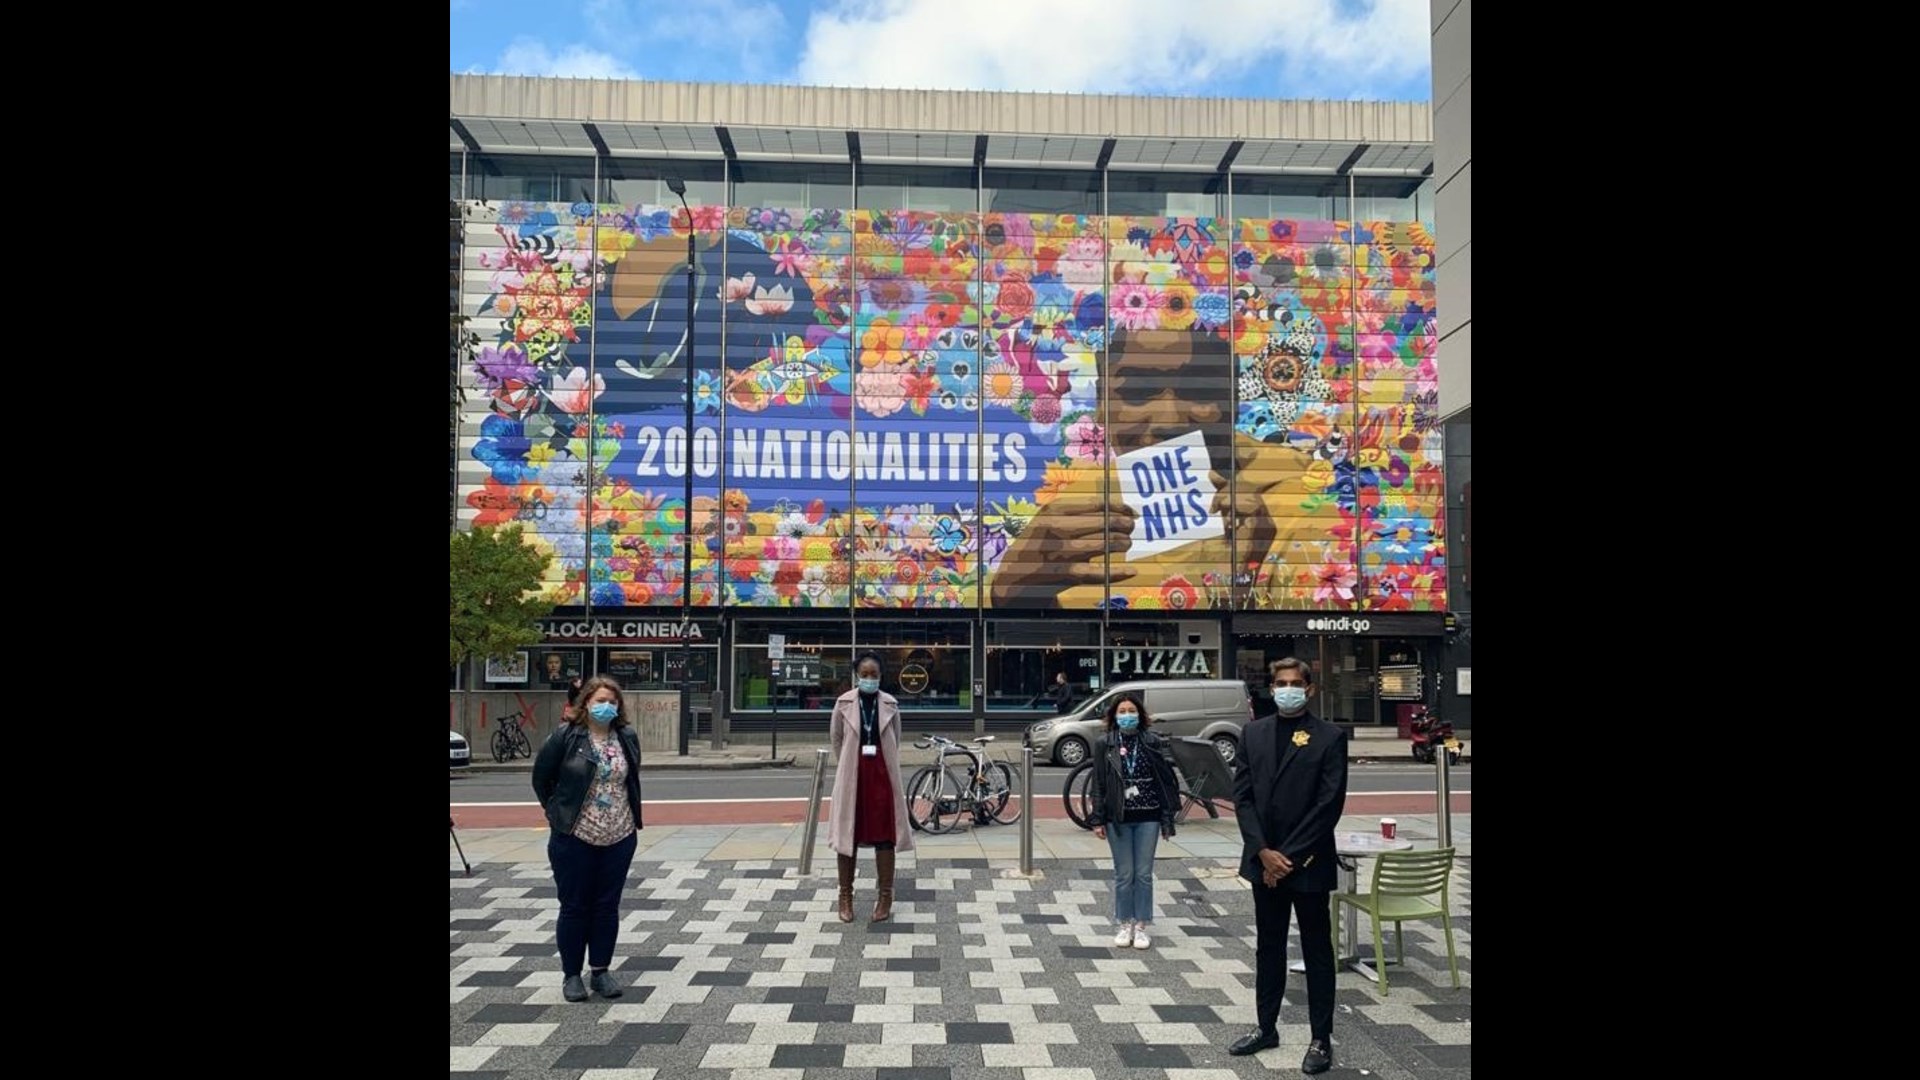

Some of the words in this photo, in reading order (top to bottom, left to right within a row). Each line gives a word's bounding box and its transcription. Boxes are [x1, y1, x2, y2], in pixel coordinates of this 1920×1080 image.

[636, 426, 718, 478] 200
[733, 427, 1028, 482] NATIONALITIES
[1131, 446, 1198, 499] ONE
[1142, 488, 1210, 542] NHS
[550, 622, 617, 638] LOCAL
[623, 622, 702, 638] CINEMA
[1078, 657, 1098, 668] OPEN
[1111, 649, 1210, 674] PIZZA
